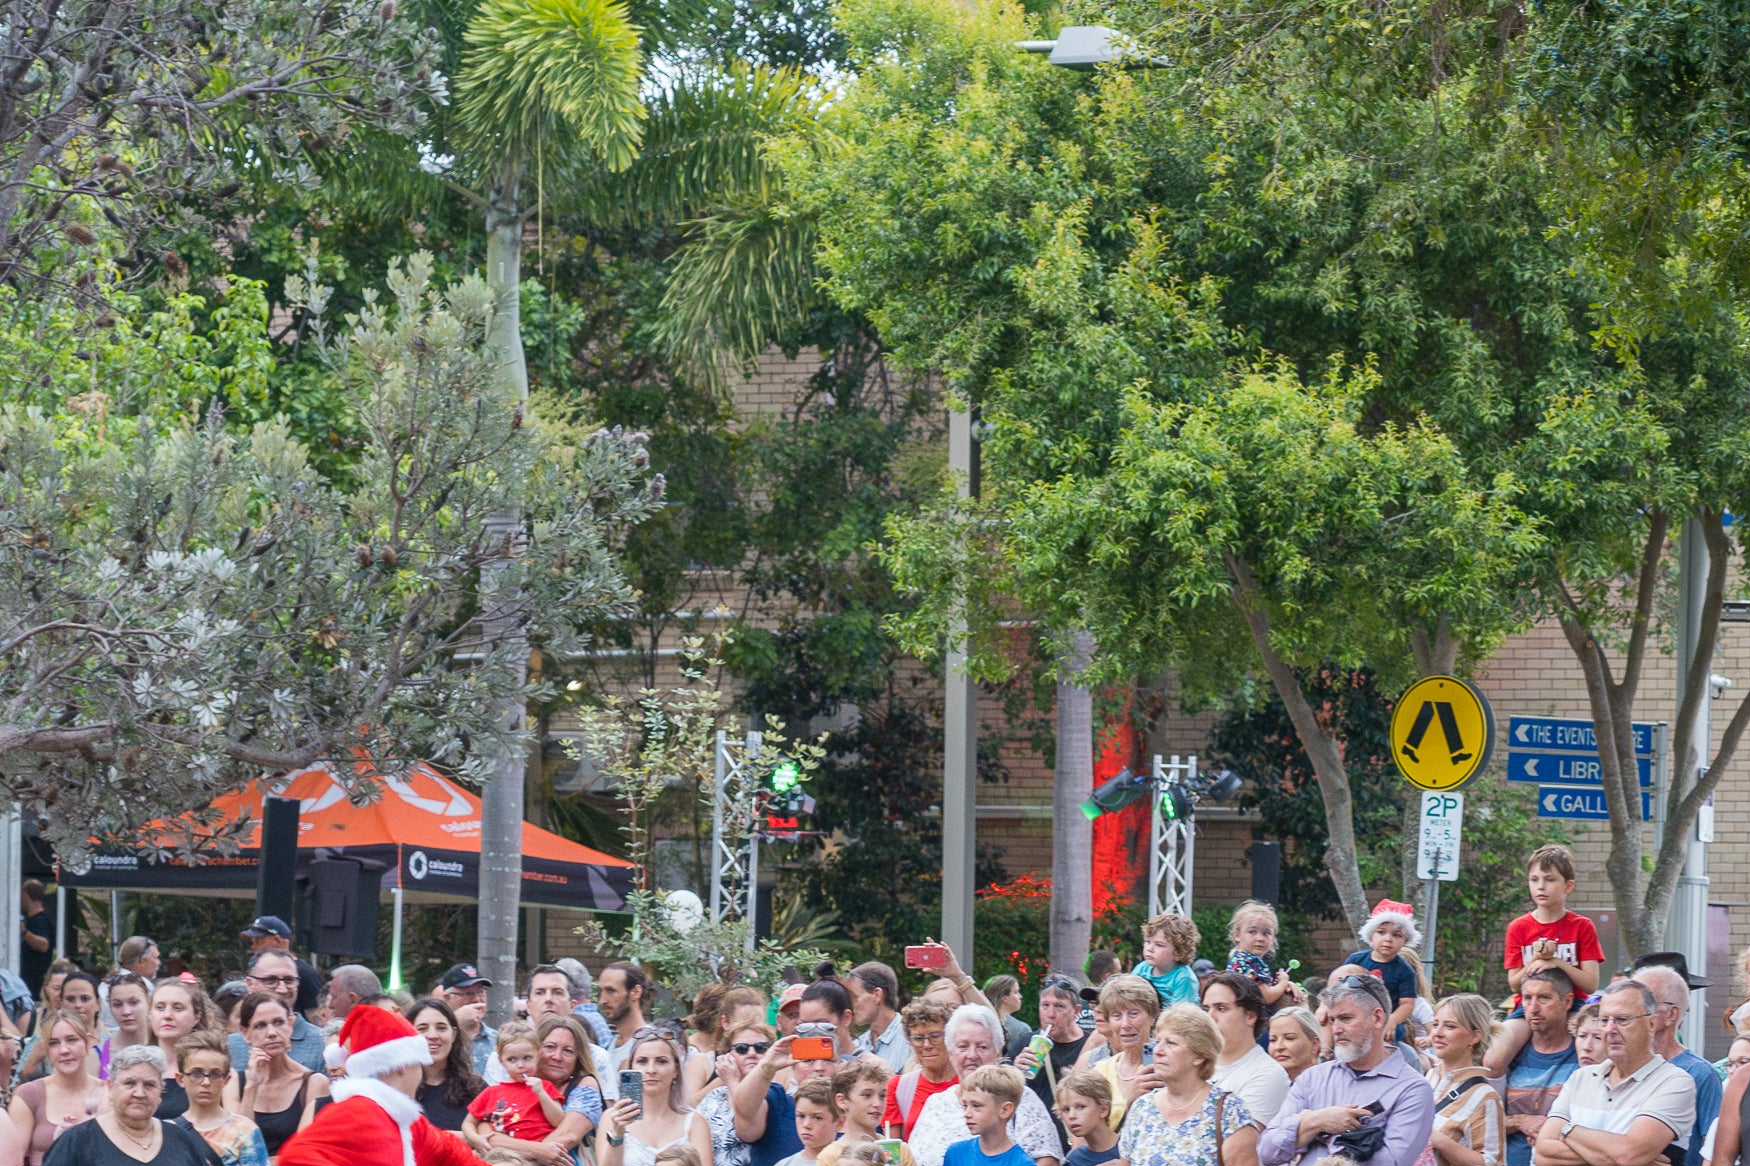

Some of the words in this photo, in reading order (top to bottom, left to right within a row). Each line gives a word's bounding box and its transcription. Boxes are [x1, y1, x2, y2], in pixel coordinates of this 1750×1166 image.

[1532, 724, 1552, 744] THE
[1557, 726, 1597, 746] EVENTS
[1559, 760, 1601, 780] LIBR
[1426, 796, 1458, 817] 2P
[1561, 794, 1608, 814] GALL
[93, 855, 138, 865] caloundra
[428, 860, 464, 873] caloundra
